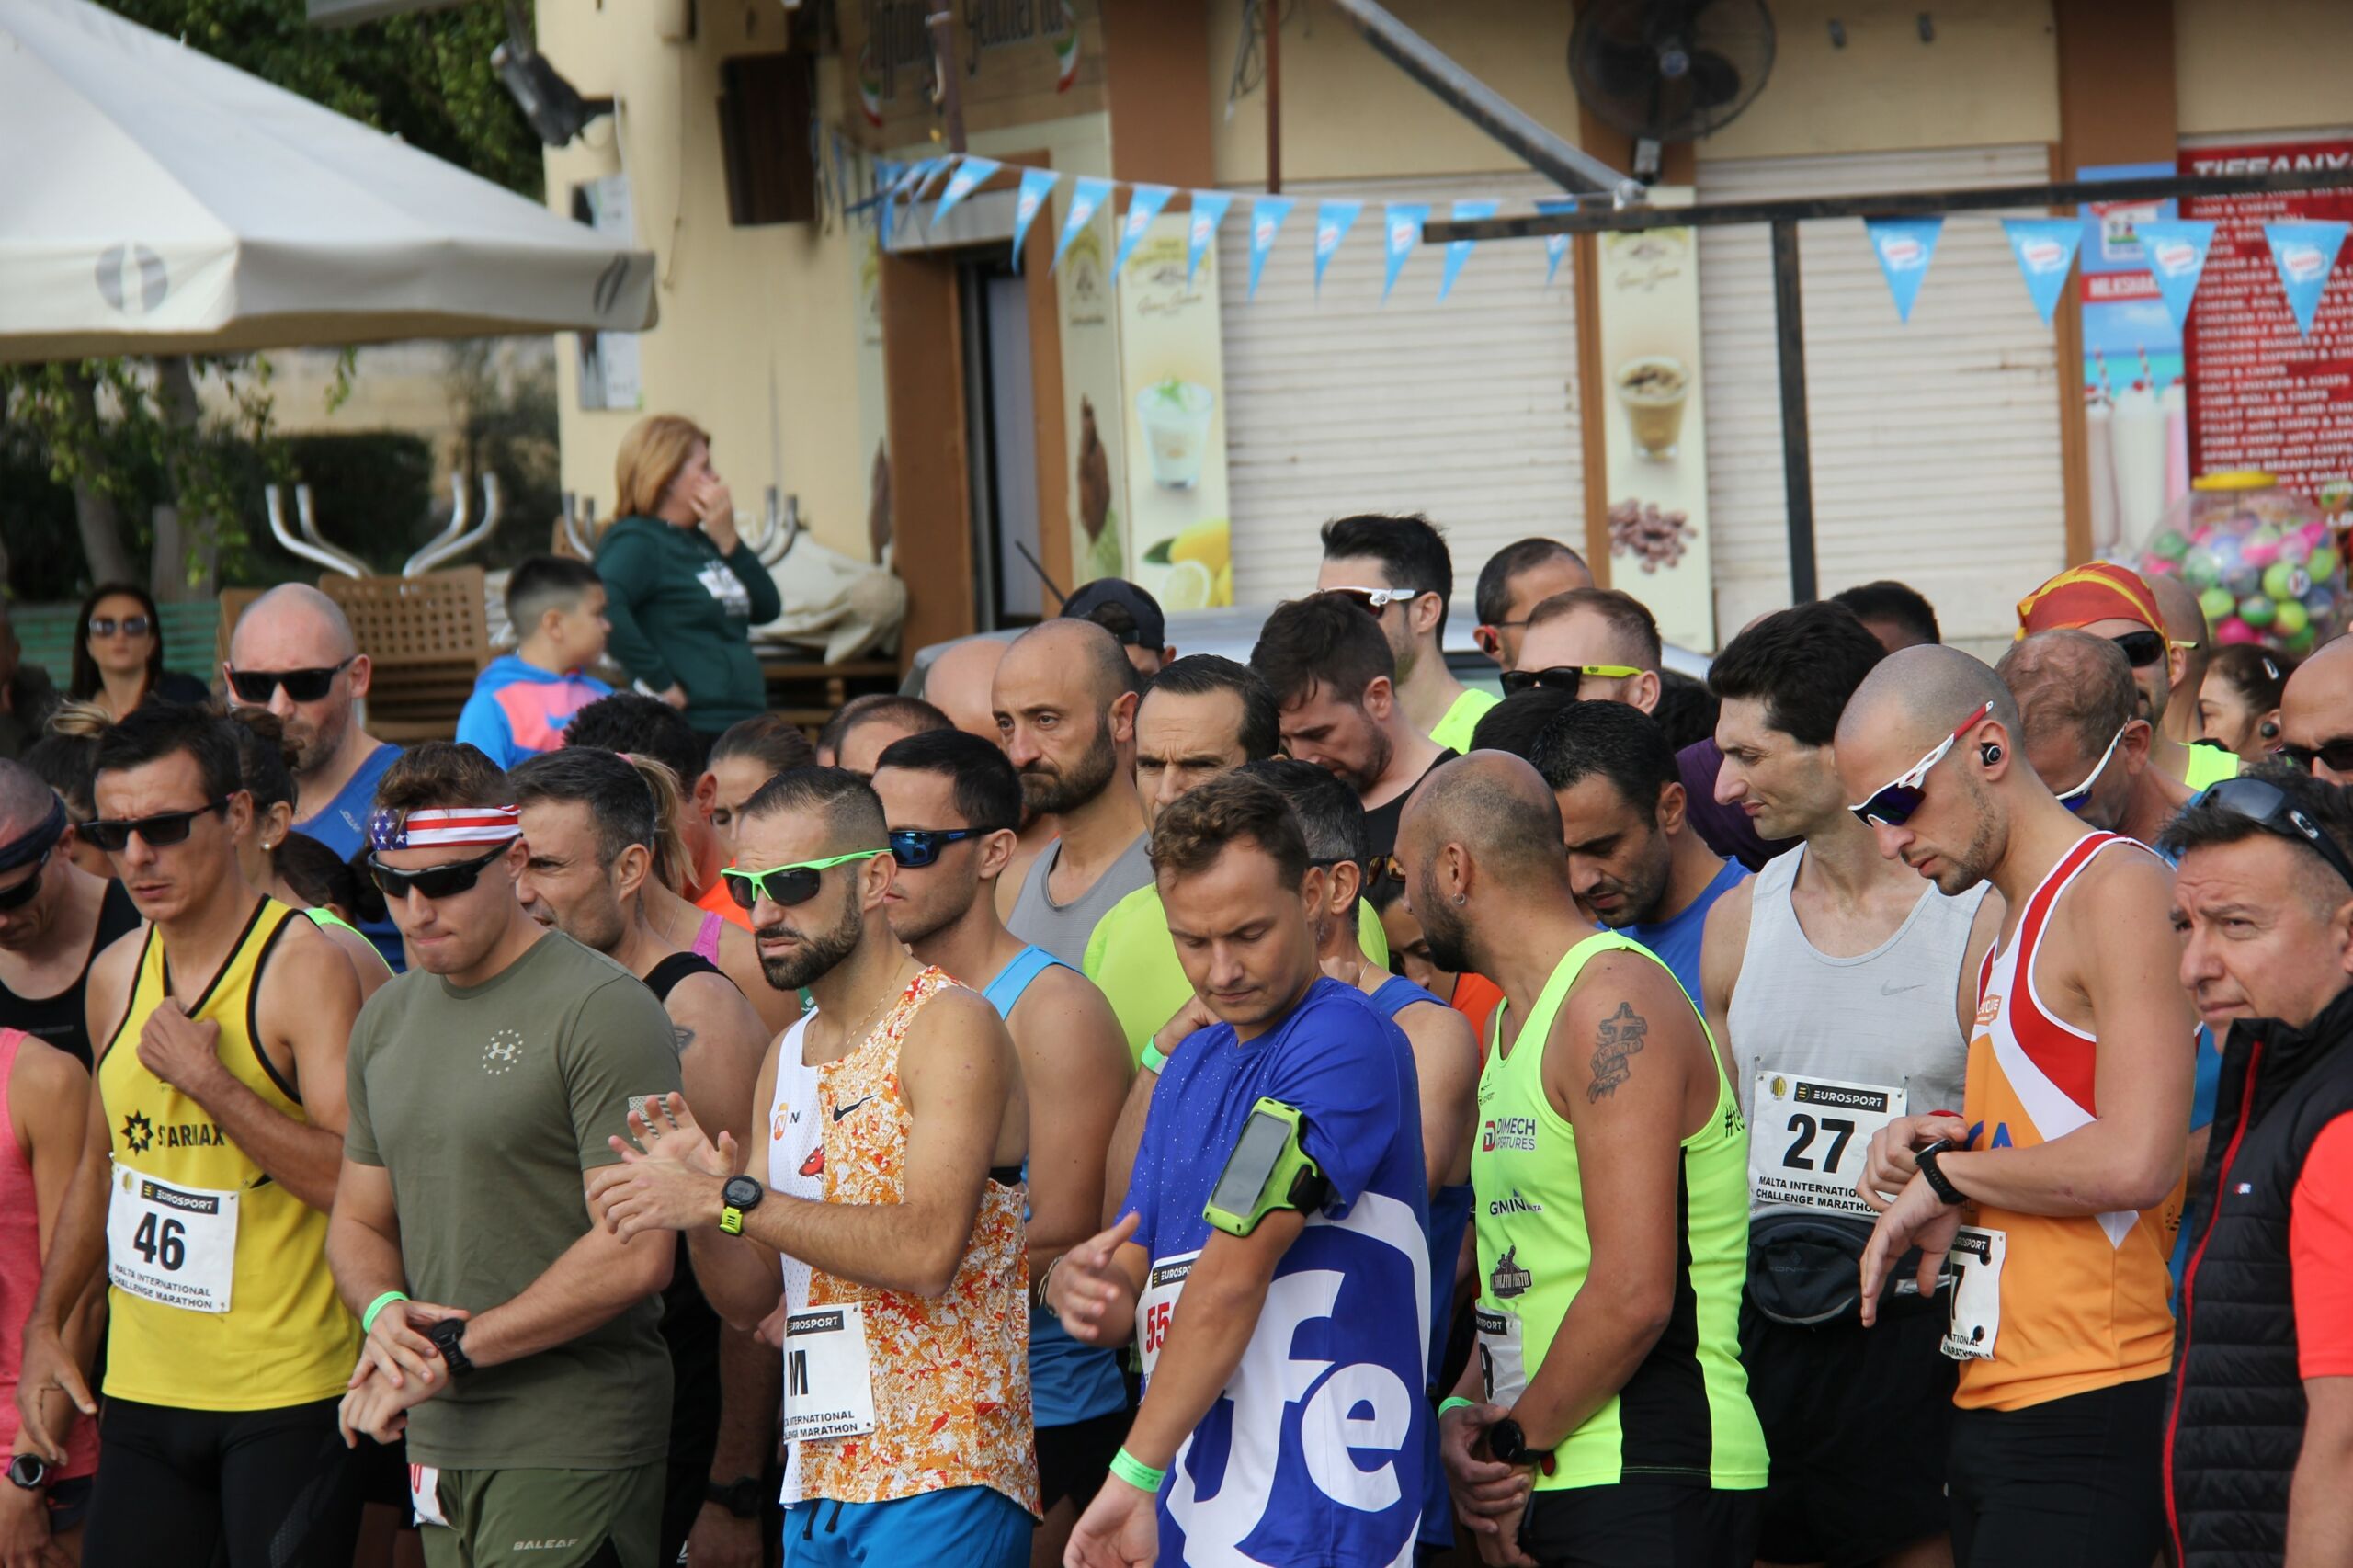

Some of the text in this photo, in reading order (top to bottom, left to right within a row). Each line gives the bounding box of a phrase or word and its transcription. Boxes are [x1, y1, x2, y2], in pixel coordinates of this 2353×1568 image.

[1813, 1090, 1882, 1108] EUROSPORT
[1783, 1113, 1855, 1174] 27
[1758, 1176, 1861, 1198] MALTA INTERNATIO
[156, 1189, 214, 1210] EUROSPORT
[1756, 1188, 1881, 1214] CHALLENGE MARATHO
[132, 1211, 185, 1271] 46
[1161, 1266, 1192, 1281] EUROSPO
[137, 1273, 211, 1296] INTERNATIONAL
[155, 1290, 212, 1309] MARATHON
[789, 1350, 809, 1397] M
[801, 1423, 858, 1437] MARATHON
[513, 1539, 579, 1551] BALEAF
